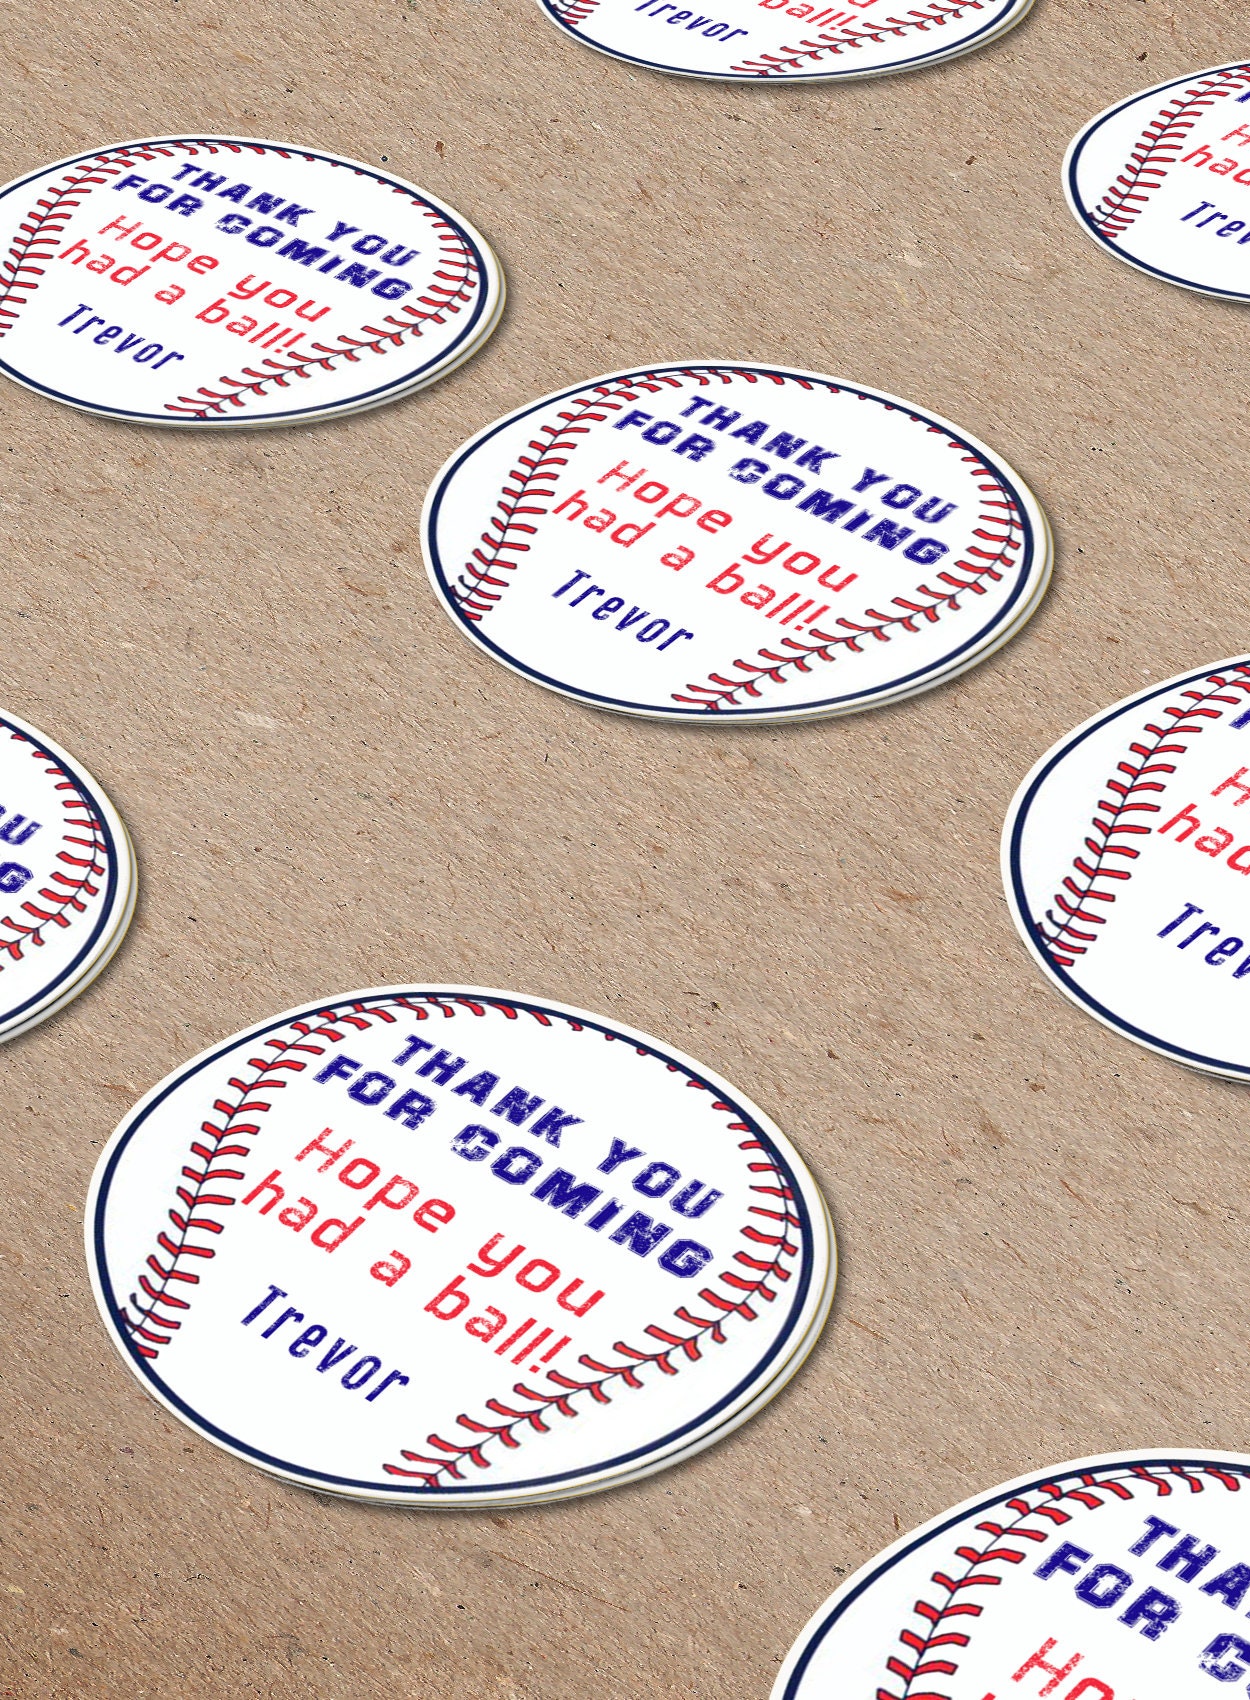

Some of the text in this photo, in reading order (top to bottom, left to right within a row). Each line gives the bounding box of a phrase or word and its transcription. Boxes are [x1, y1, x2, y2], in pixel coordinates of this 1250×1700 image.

[98, 215, 331, 322] Hope you
[114, 174, 412, 300] FOR COMING
[173, 163, 419, 266] THANK YOU
[58, 239, 306, 353] had a ball!
[59, 304, 184, 370] Trevor
[614, 410, 948, 565] FOR COMING
[681, 396, 957, 523] THANK YOU
[553, 489, 830, 631] had a ball!
[597, 460, 858, 592] Hope you
[553, 570, 694, 651] Trevor
[314, 1055, 712, 1278] FOR COMING
[394, 1035, 722, 1218] THANK YOU
[242, 1169, 572, 1373] had a ball!
[295, 1127, 605, 1317] Hope you
[242, 1285, 409, 1402] Trevor
[1035, 1542, 1179, 1641] FOR
